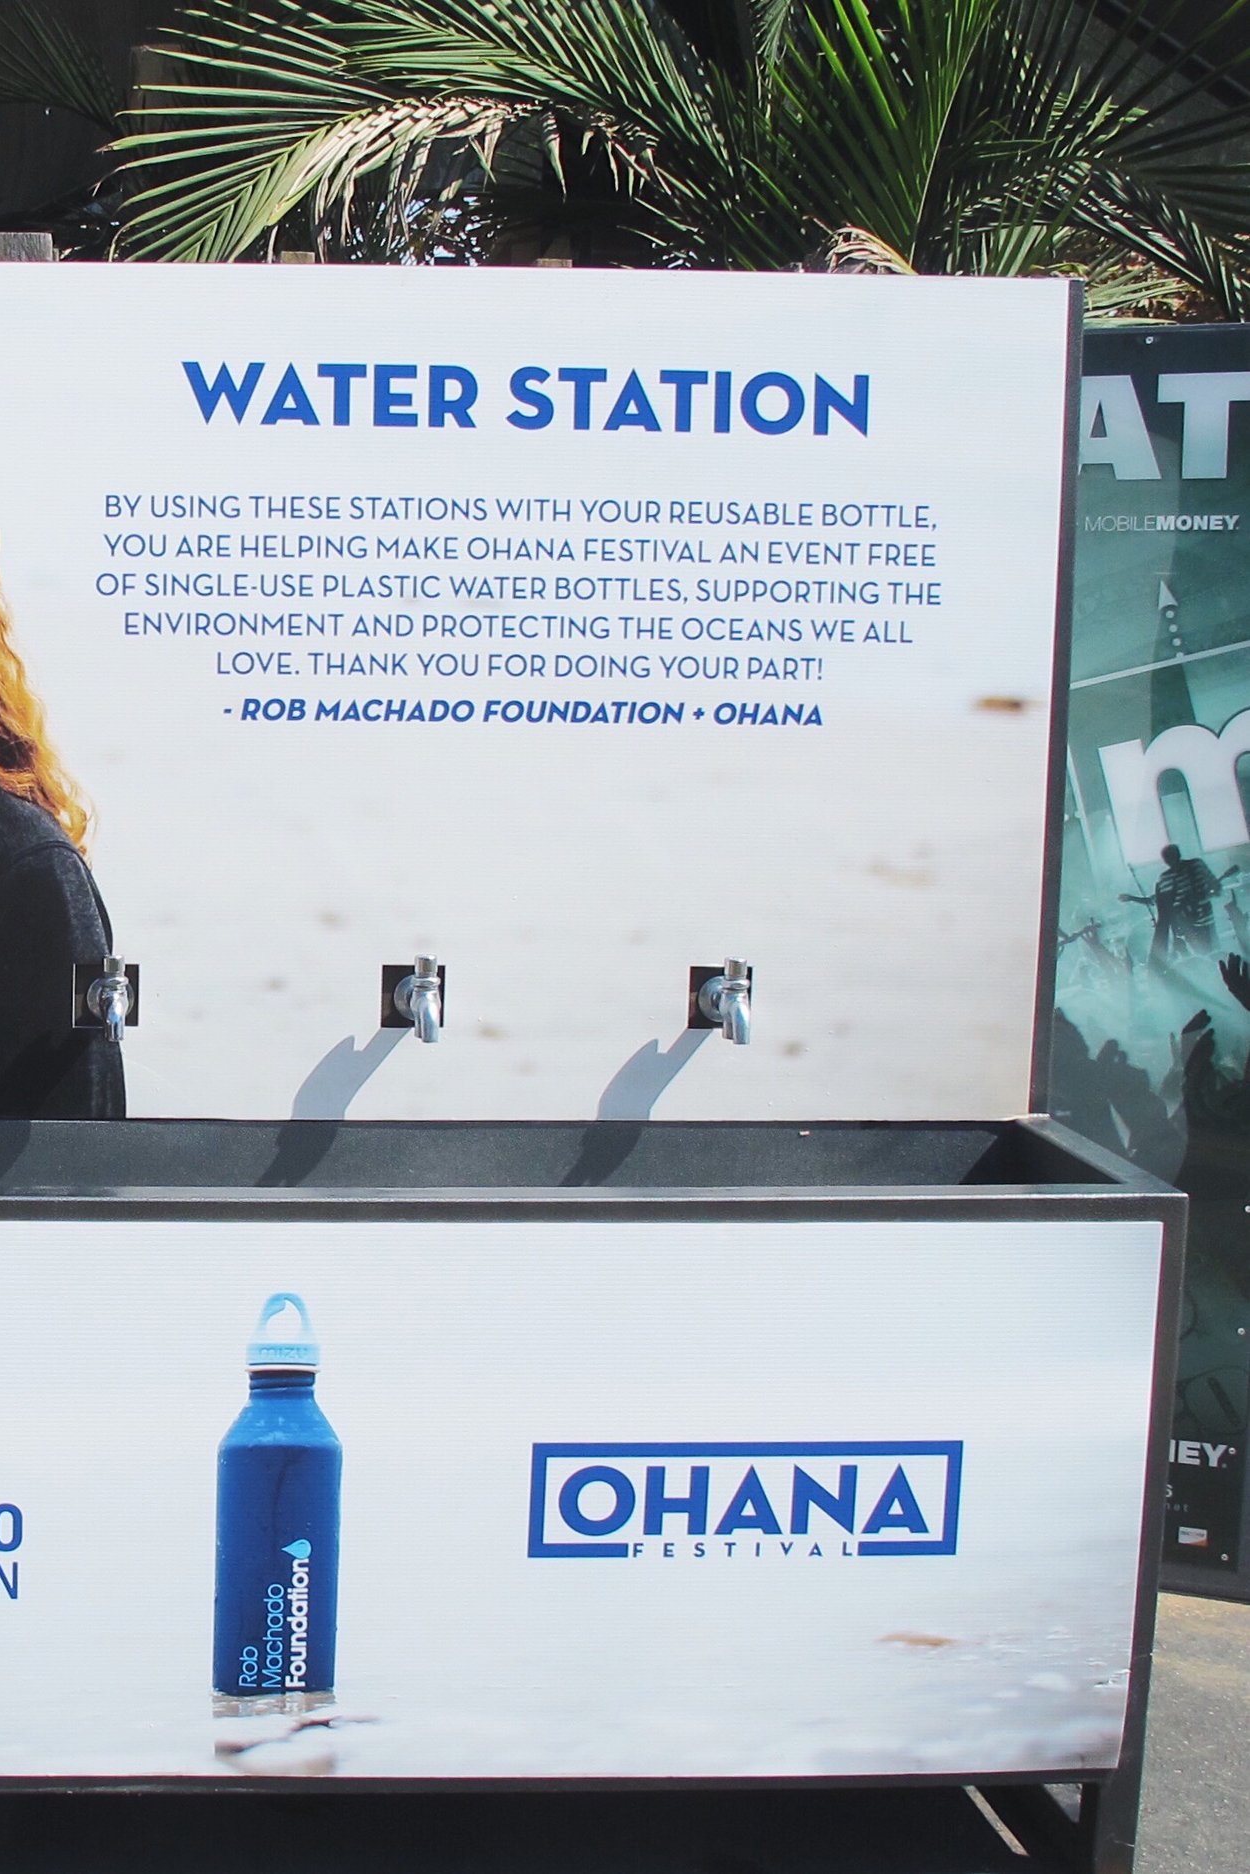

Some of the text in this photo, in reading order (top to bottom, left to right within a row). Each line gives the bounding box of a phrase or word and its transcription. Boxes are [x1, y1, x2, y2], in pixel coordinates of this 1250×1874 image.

[182, 361, 872, 437] WATER STATION
[104, 494, 939, 529] BY USING THESE STATIONS WITH YOUR REUSABLE BOTTLE,
[104, 533, 938, 568] YOU ARE HELPING MAKE OHANA FESTIVAL AN EVENT FREE
[94, 572, 942, 606] OF SINGLE-USE PLASTIC WATER BOTTLES, SUPPORTING THE
[124, 611, 914, 645] ENVIRONMENT AND PROTECTING THE OCEANS WE ALL
[217, 652, 826, 680] LOVE. THANK YOU FOR DOING YOUR PART!
[240, 698, 308, 721] ROB
[313, 699, 477, 723] MACHADO
[482, 699, 686, 725] FOUNDATION
[713, 701, 825, 726] OHANA
[558, 1463, 930, 1536] OHANA
[633, 1541, 853, 1559] FESTIVAL
[261, 1583, 285, 1688] Machado
[284, 1557, 310, 1688] Foundation
[238, 1646, 259, 1688] Rob
